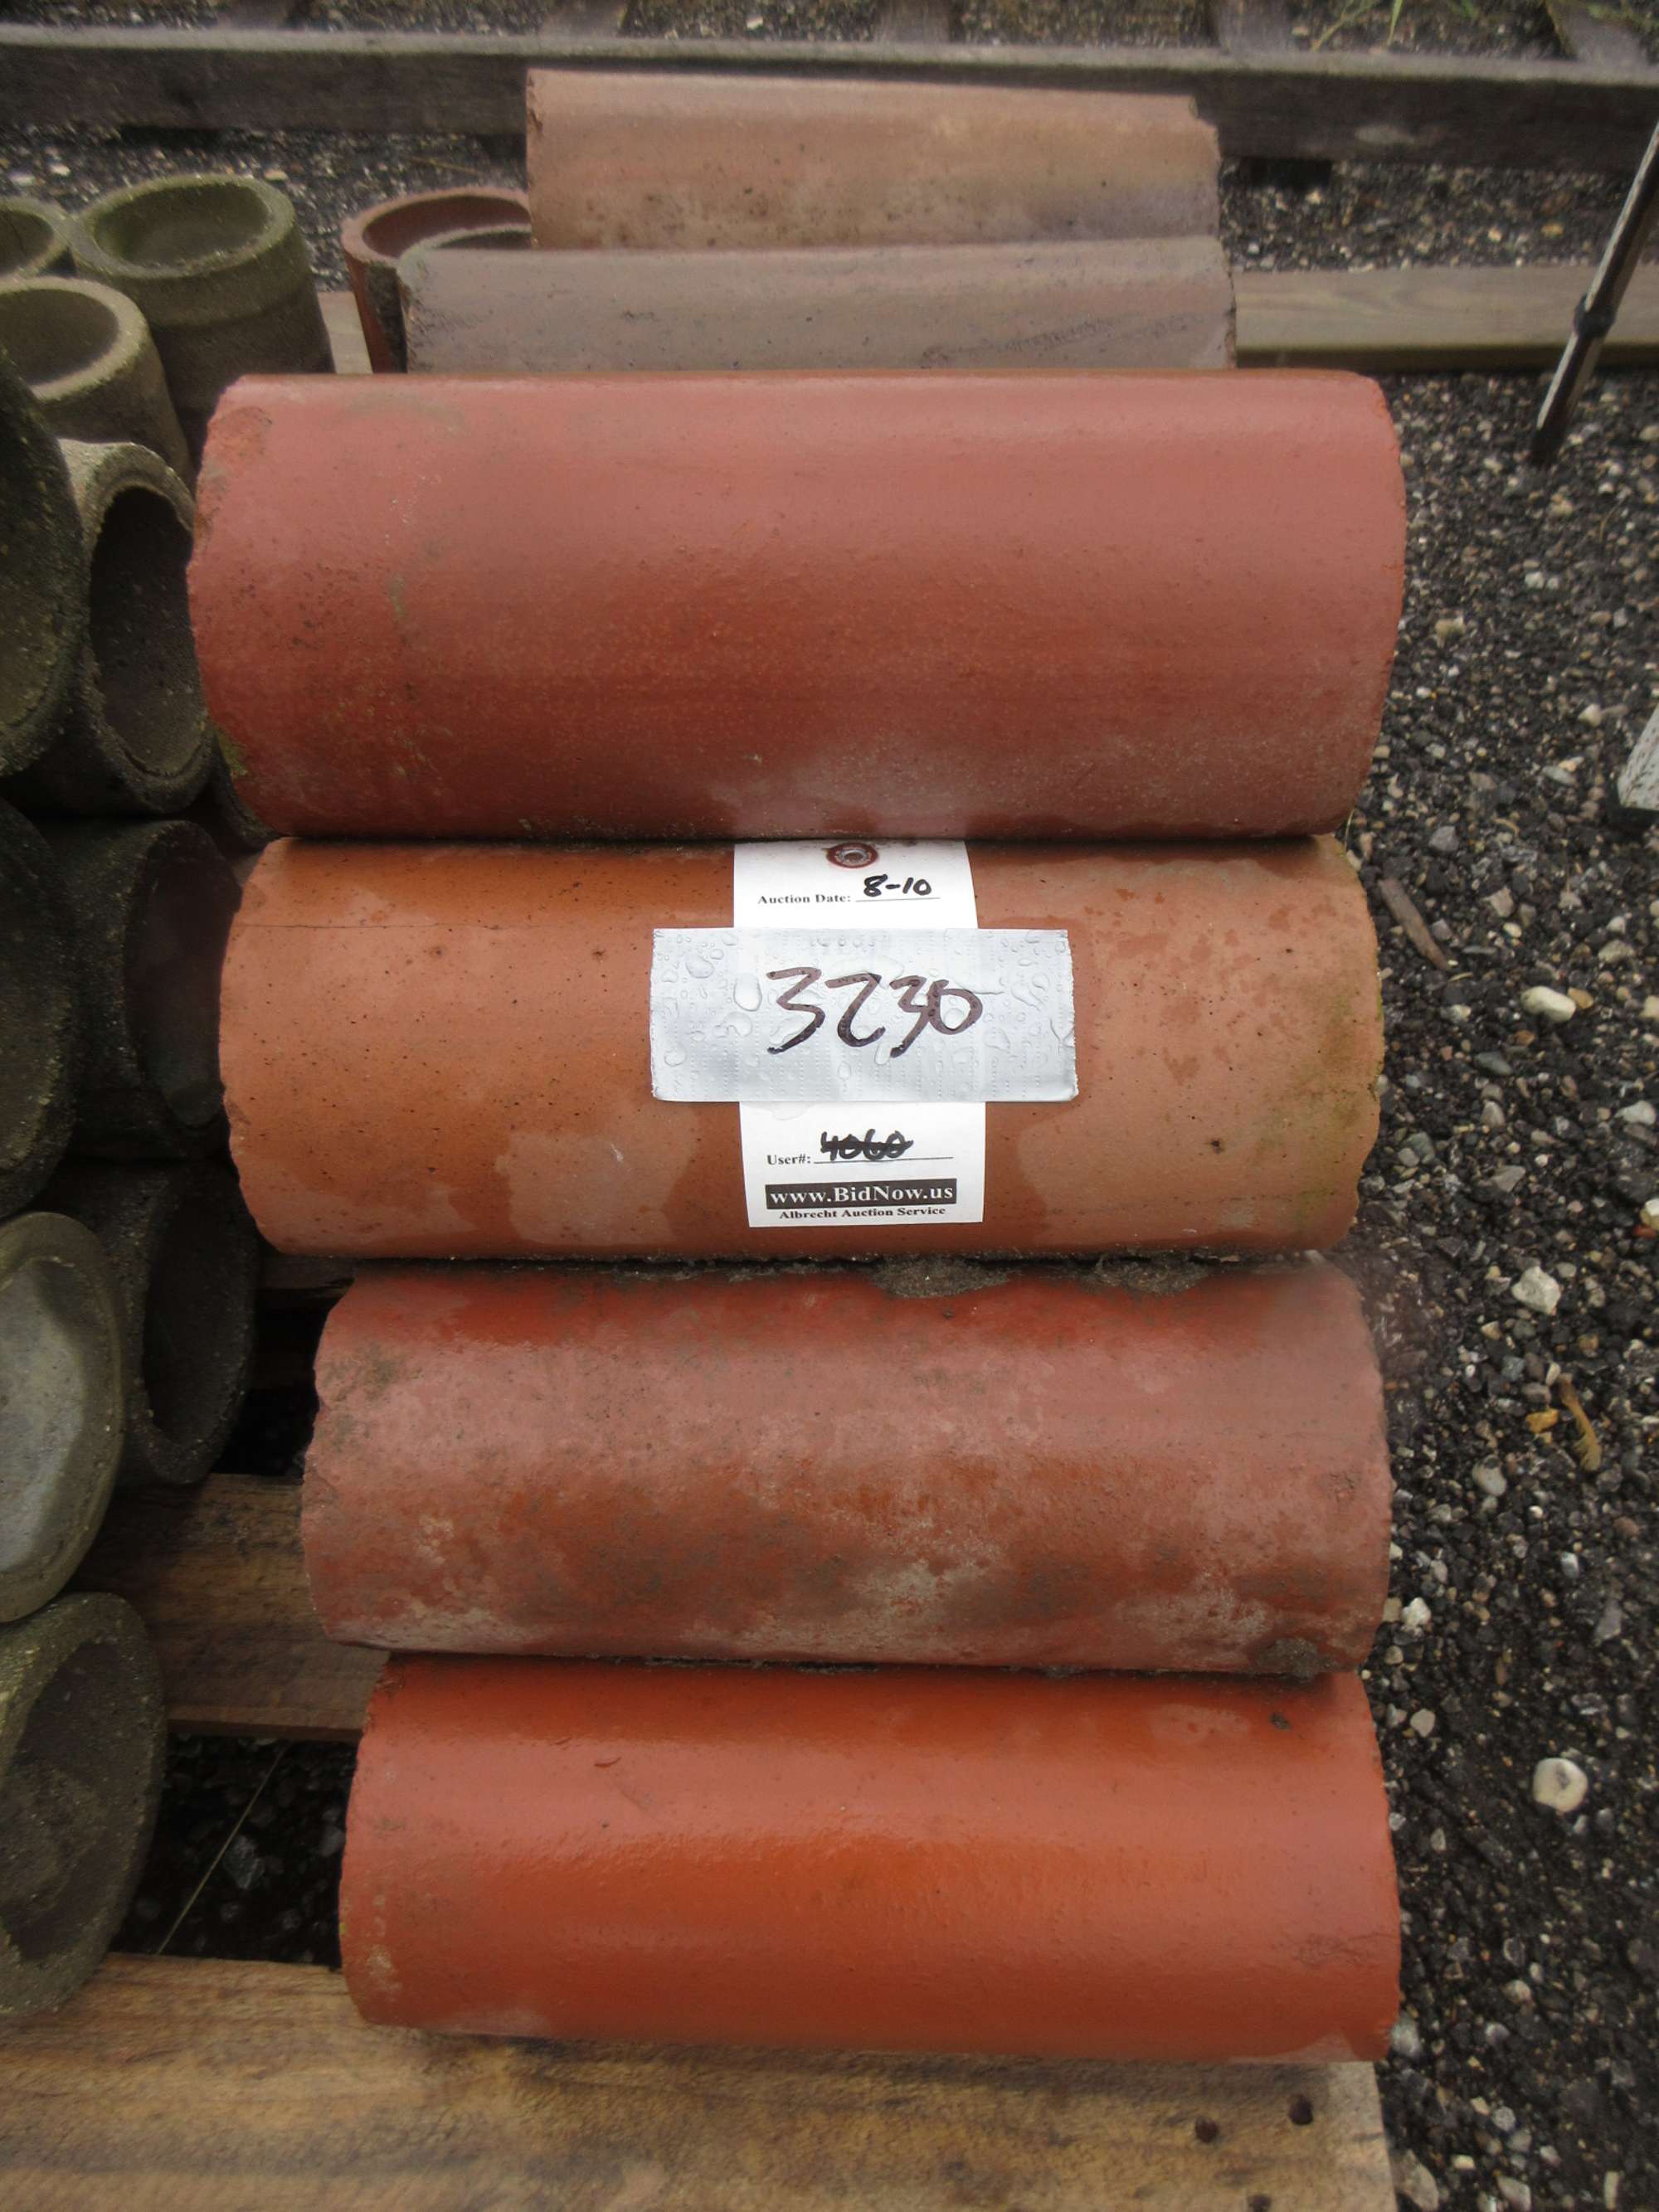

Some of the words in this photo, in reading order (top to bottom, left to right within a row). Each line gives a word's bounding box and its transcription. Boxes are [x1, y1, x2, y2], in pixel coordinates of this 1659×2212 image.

[863, 874, 932, 898] 8-10
[758, 893, 810, 905] Auction
[815, 892, 851, 904] Date:
[766, 966, 983, 1058] 3230
[766, 1152, 811, 1165] User#:
[769, 1184, 954, 1204] www.BidNow.us
[780, 1208, 836, 1219] Albrecht
[841, 1208, 892, 1218] Auction
[897, 1206, 946, 1217] Service
